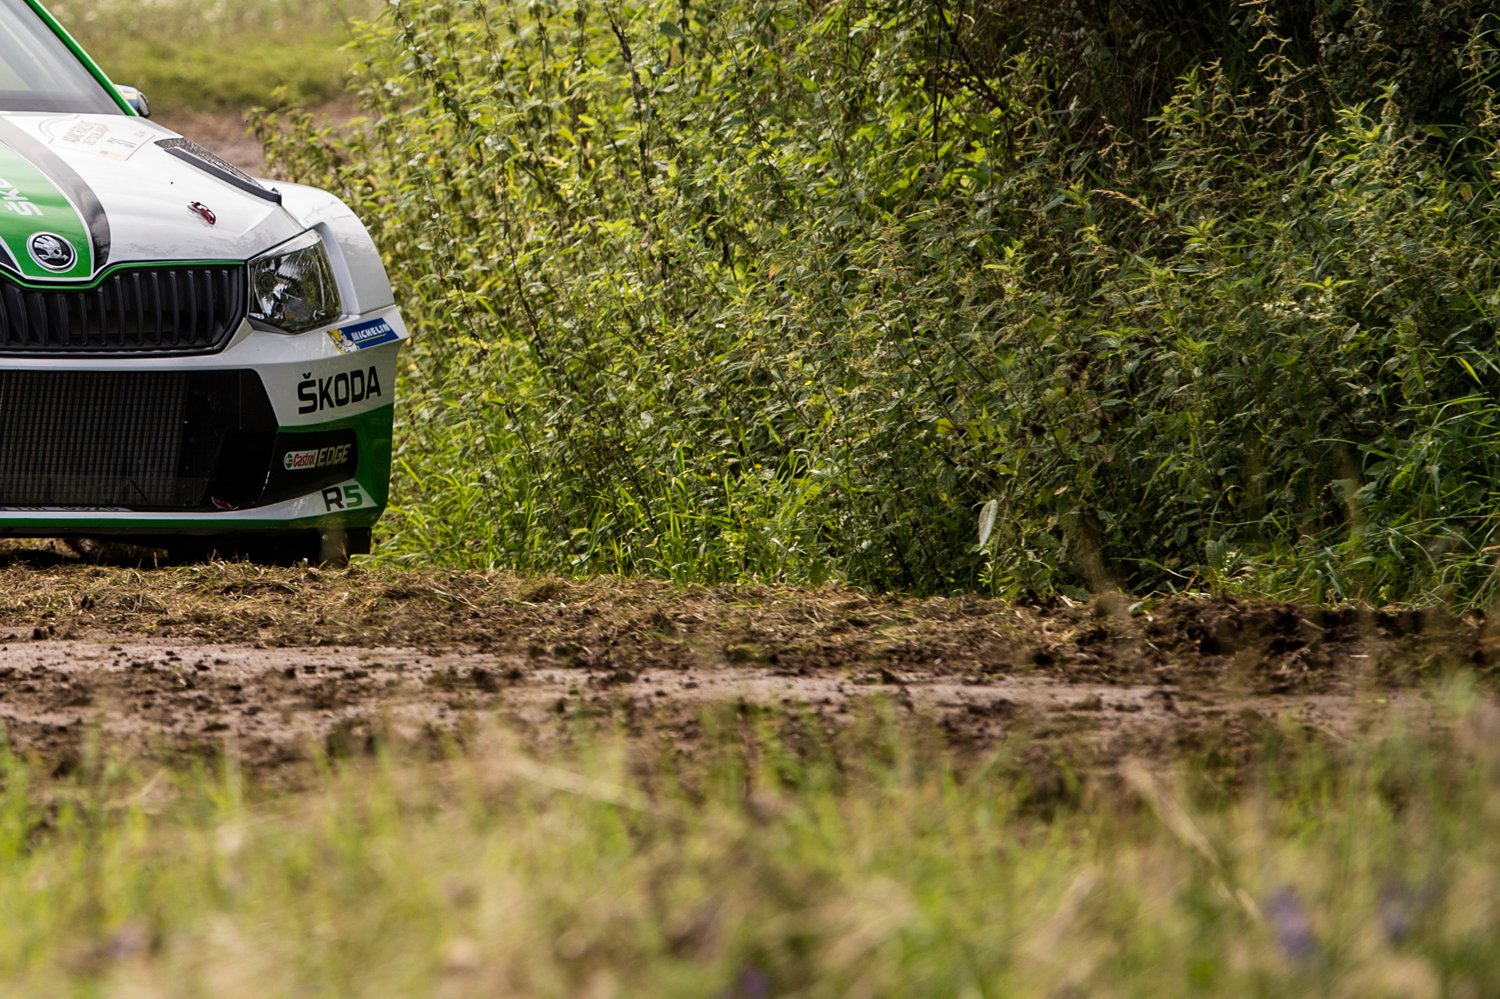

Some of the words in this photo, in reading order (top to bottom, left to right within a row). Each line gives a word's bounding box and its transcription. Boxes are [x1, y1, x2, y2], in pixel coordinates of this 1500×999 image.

[350, 323, 391, 342] MICHELIN
[297, 365, 382, 415] ŠKODA
[293, 452, 317, 468] Castrol
[317, 443, 351, 468] EDGE
[322, 484, 363, 512] R5
